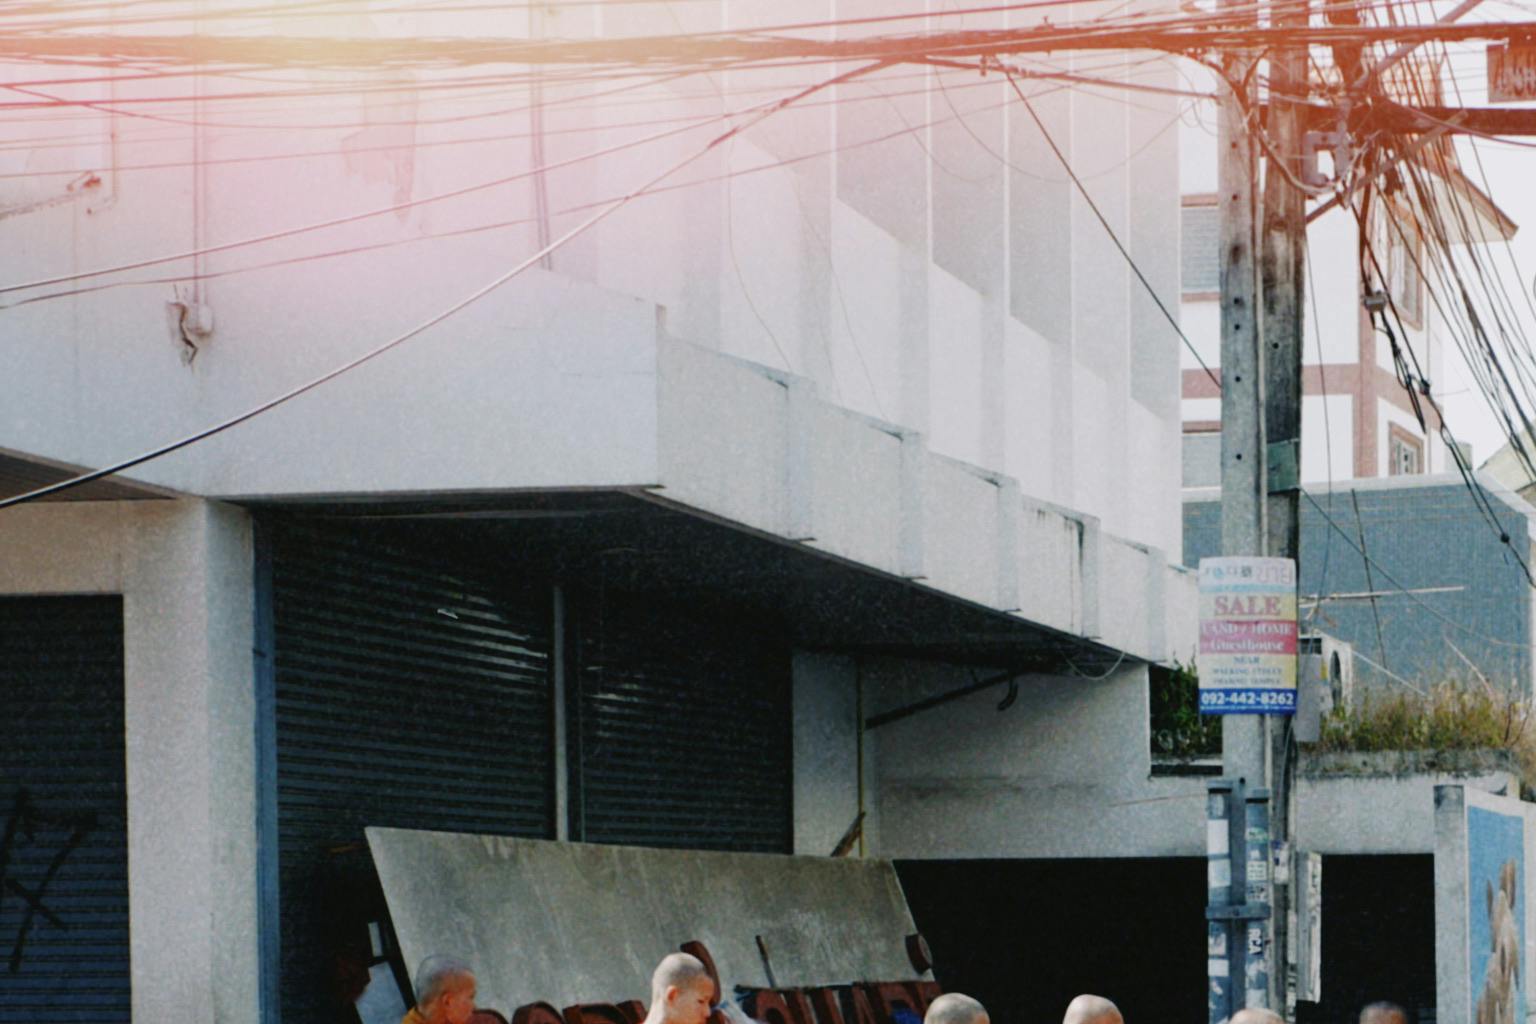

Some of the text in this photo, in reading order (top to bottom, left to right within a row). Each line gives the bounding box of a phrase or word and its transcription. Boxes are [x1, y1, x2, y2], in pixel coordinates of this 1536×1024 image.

[1214, 595, 1281, 616] SALE
[1251, 623, 1292, 635] HOME
[1201, 691, 1294, 706] 092-442-8262
